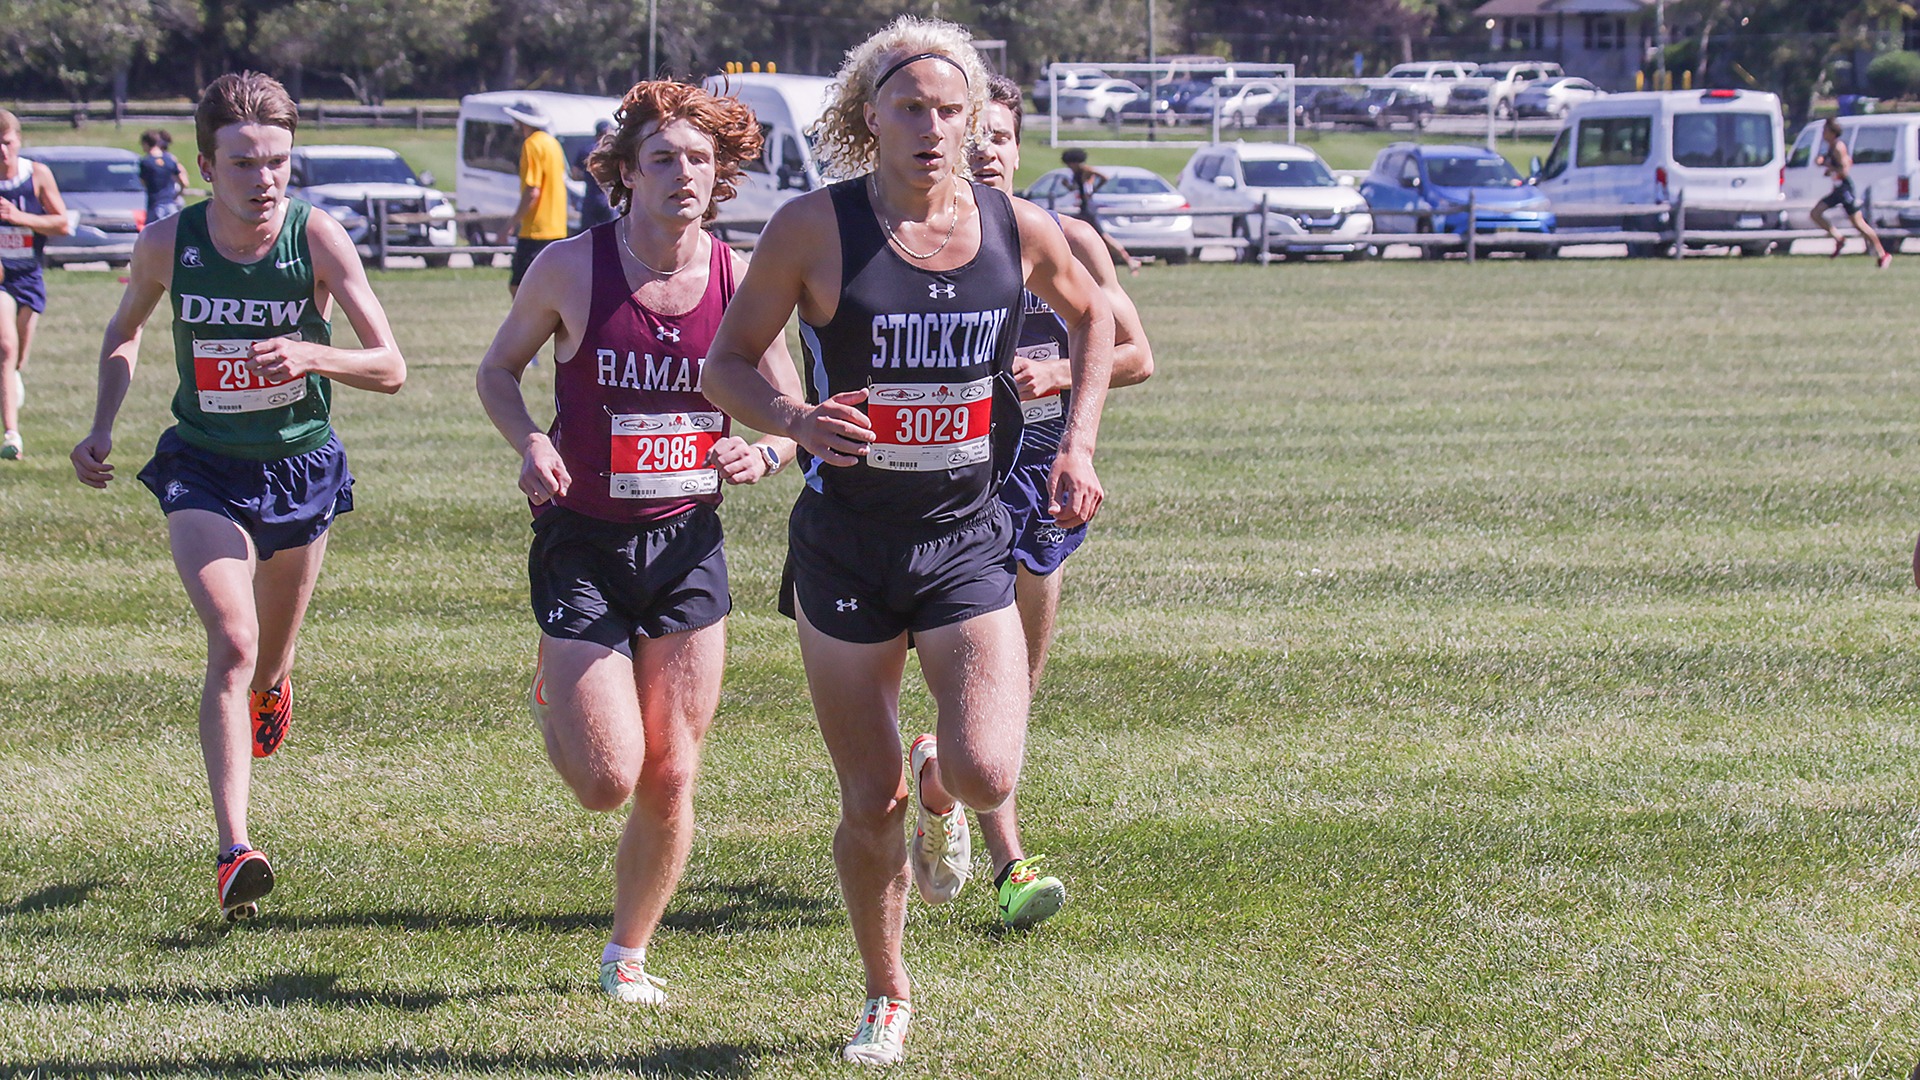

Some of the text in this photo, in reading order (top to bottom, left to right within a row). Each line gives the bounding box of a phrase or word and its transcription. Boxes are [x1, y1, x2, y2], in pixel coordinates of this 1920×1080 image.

[180, 293, 308, 327] DREW
[872, 307, 1008, 369] STOCKTON
[217, 359, 282, 389] 29
[596, 348, 705, 393] RAMA
[895, 406, 970, 443] 3029
[637, 435, 698, 471] 2985
